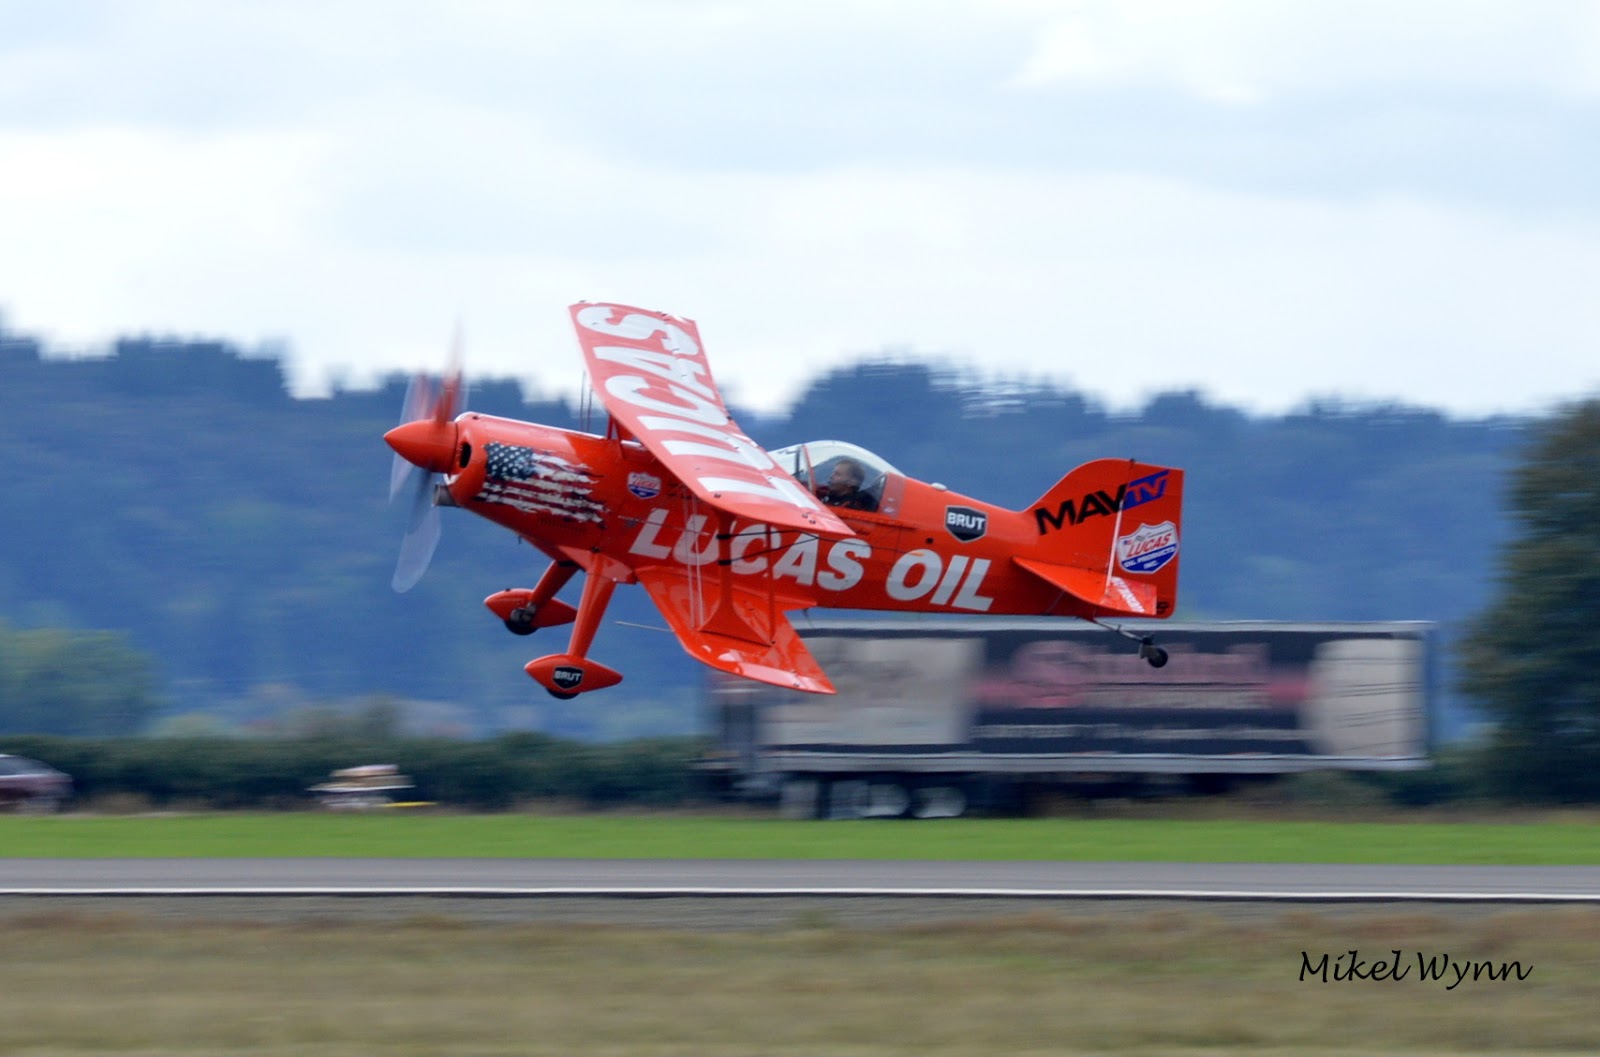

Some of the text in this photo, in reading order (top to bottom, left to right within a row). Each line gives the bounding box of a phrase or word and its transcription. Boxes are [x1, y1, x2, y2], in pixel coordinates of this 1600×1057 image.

[577, 306, 820, 511] LUCAS
[946, 511, 986, 530] BRUT
[1126, 532, 1173, 558] LUCAS
[628, 508, 994, 612] LUCAS OIL
[554, 670, 582, 681] BRUT
